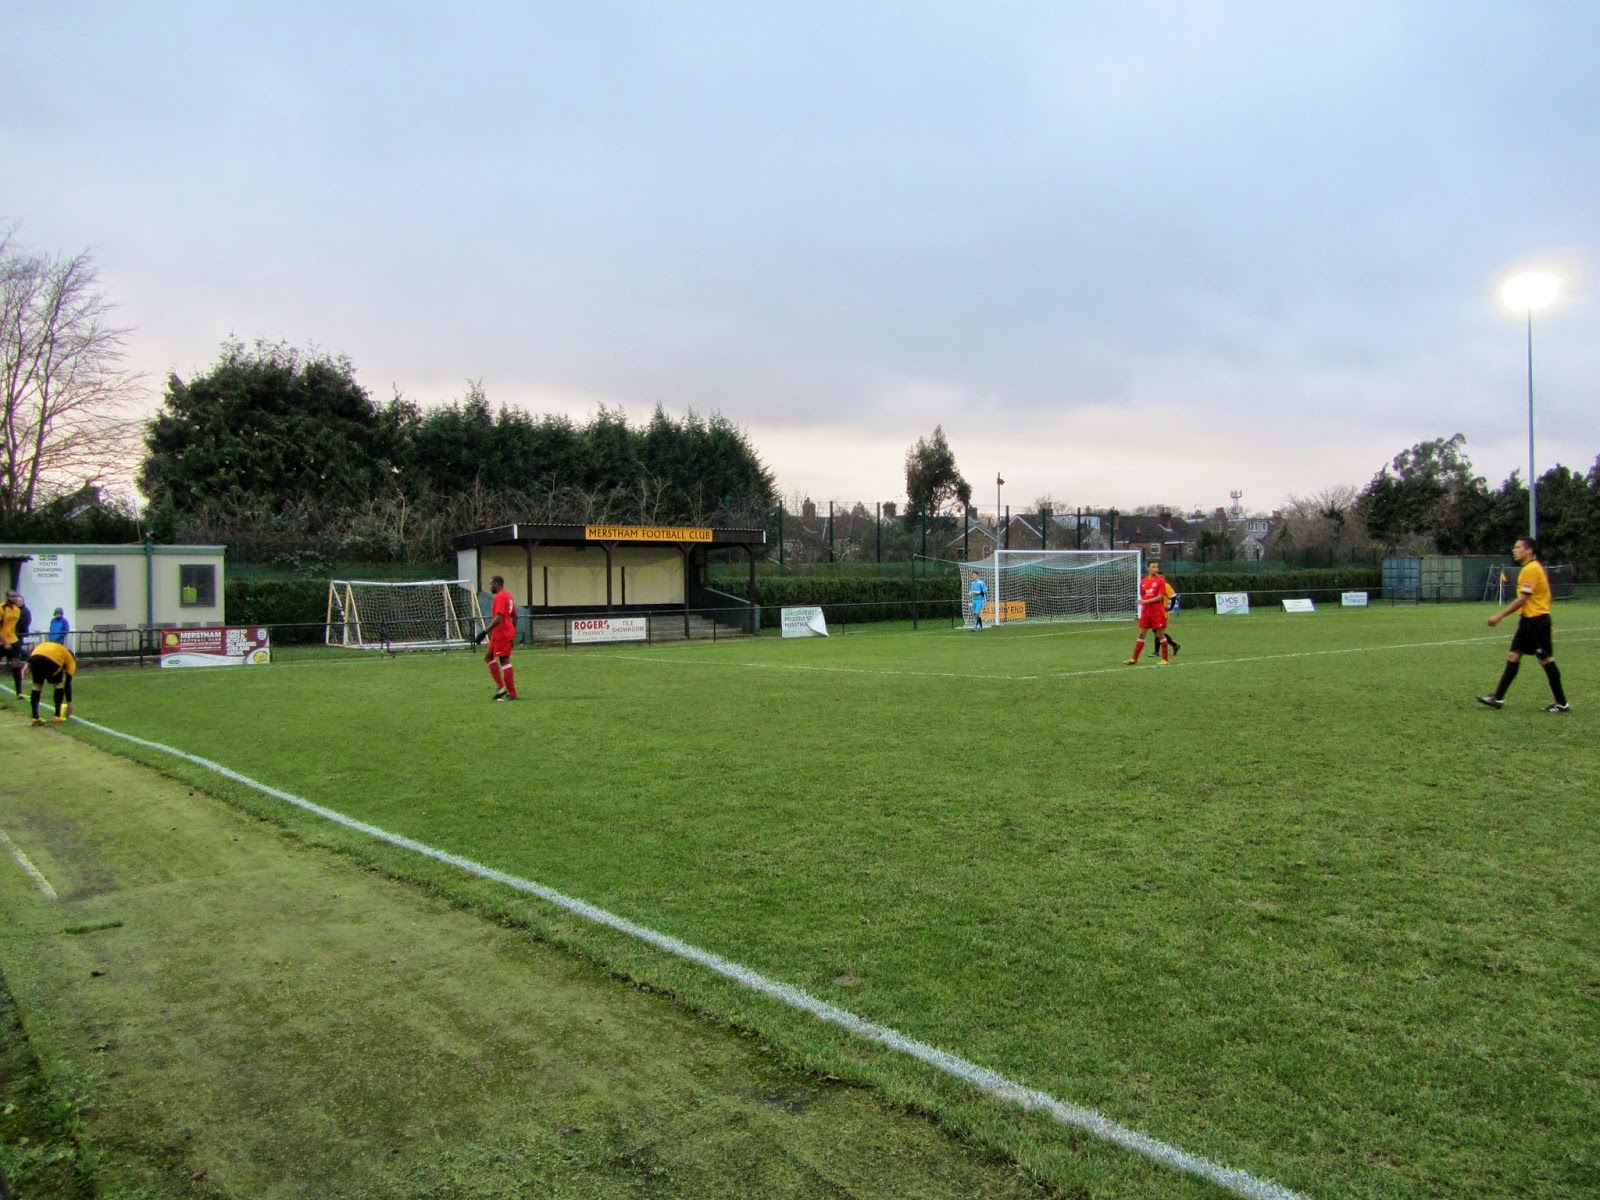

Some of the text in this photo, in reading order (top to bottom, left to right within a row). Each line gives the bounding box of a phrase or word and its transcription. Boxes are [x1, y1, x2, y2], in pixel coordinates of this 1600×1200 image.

[588, 529, 710, 540] MERSTHAM FOOTBALL CLUB
[574, 620, 610, 630] ROGERS
[612, 626, 645, 634] SHOWROOM
[180, 631, 221, 639] MERSTHAM
